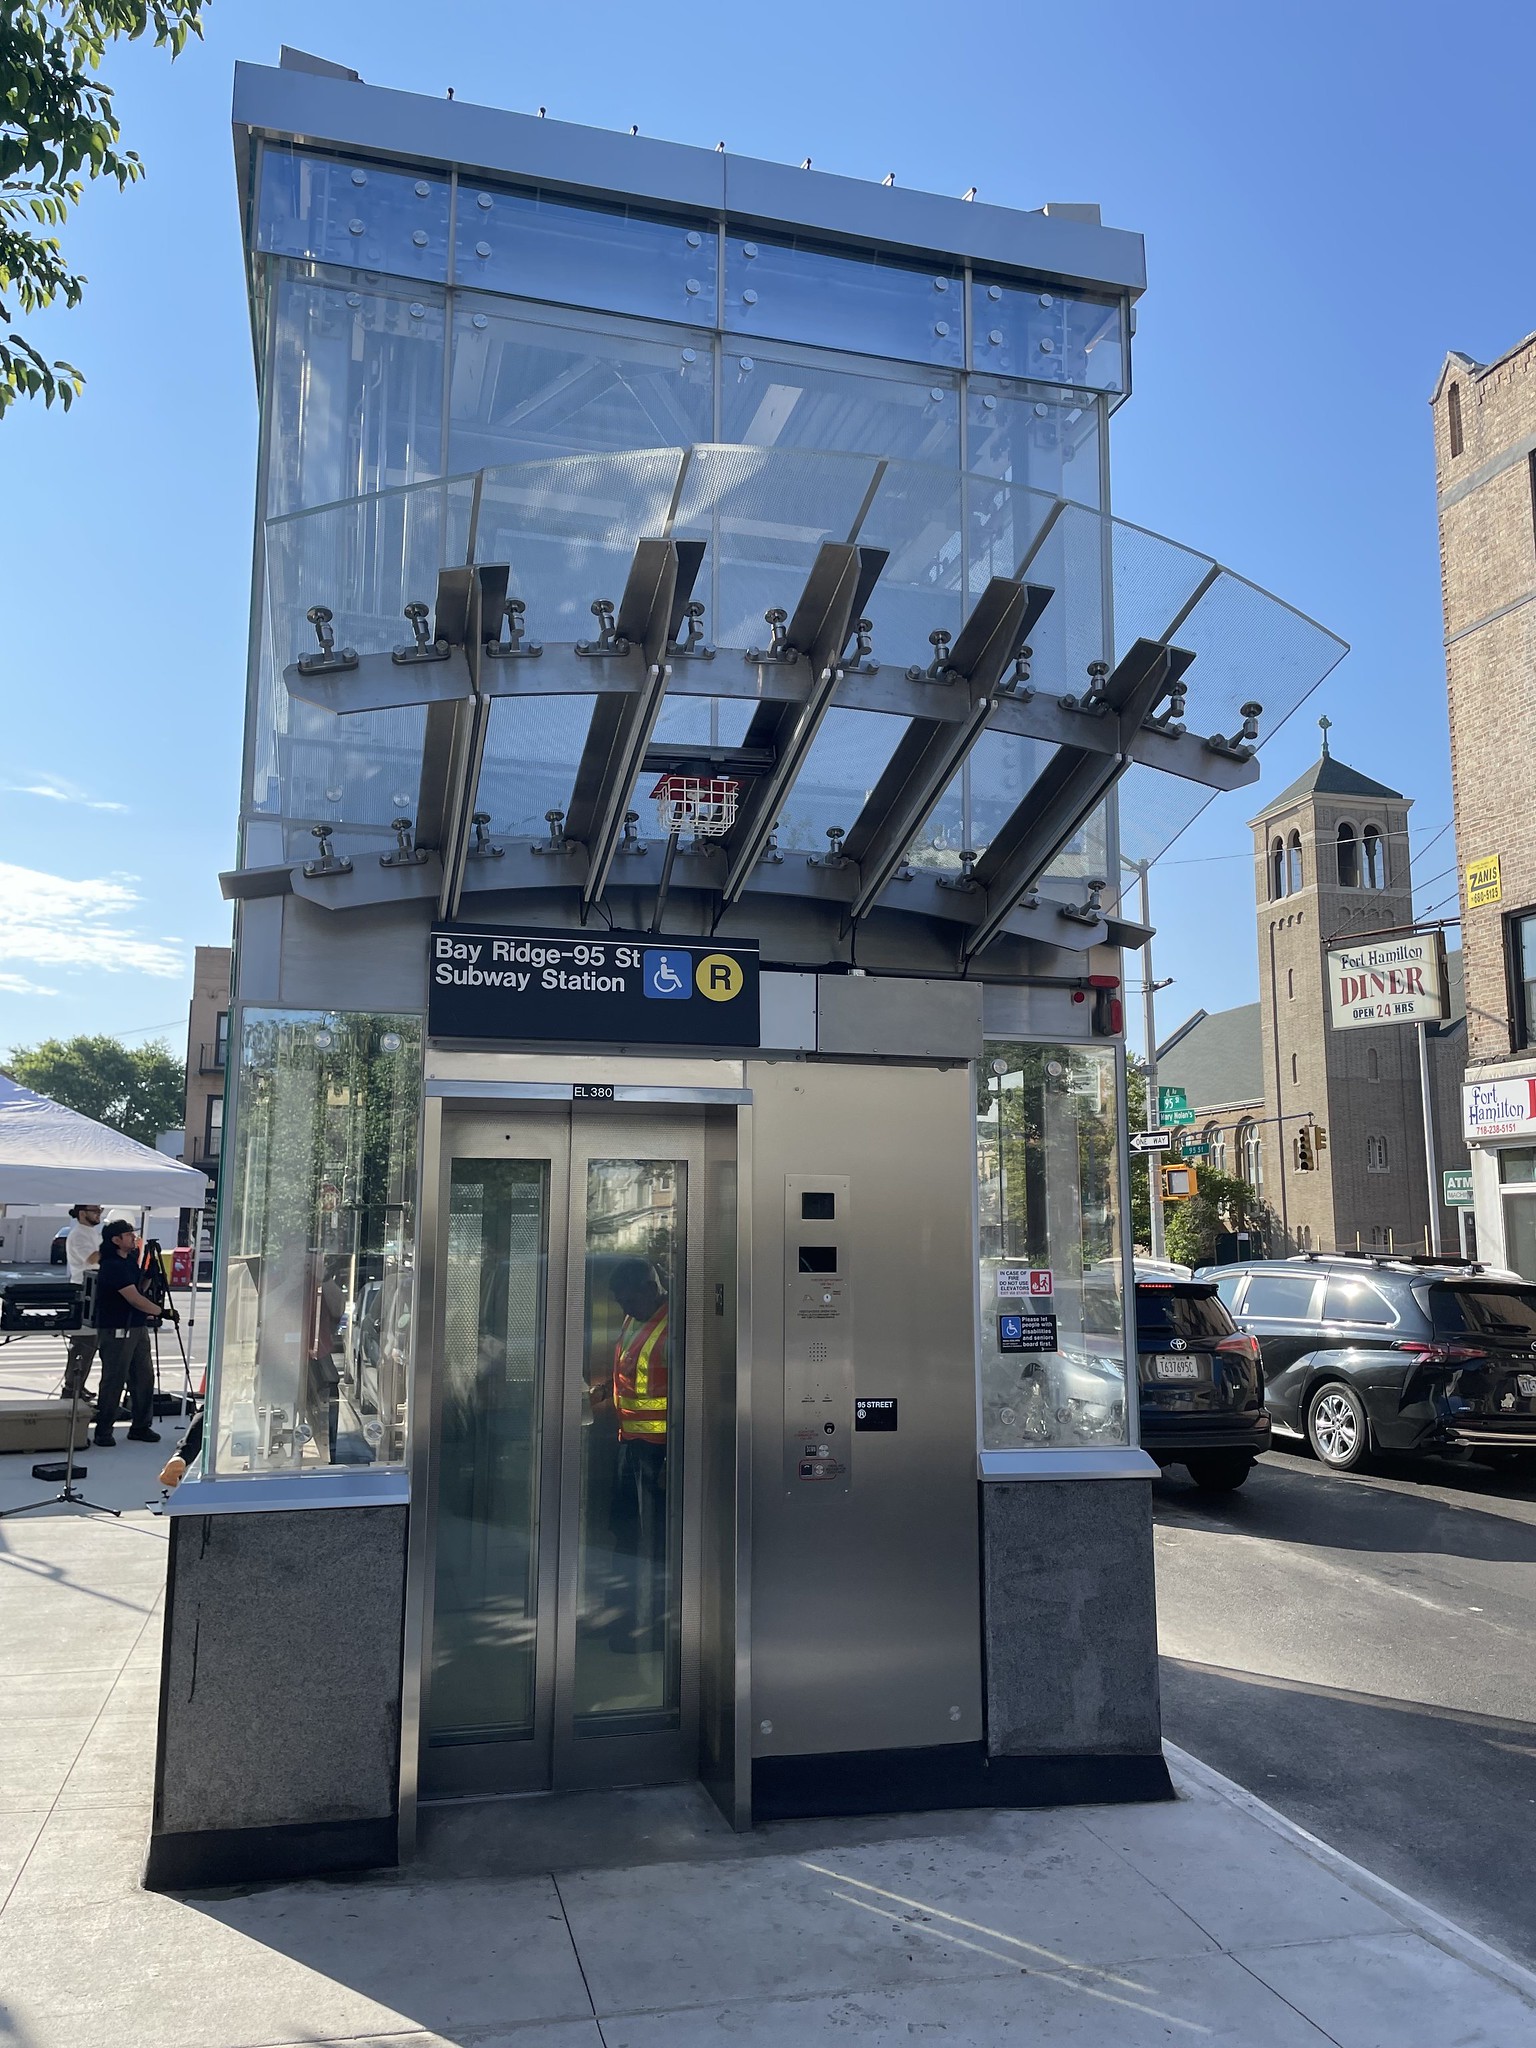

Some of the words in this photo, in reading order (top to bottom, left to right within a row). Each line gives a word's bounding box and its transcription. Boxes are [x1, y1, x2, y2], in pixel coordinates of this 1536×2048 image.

[1470, 867, 1498, 892] ZANIS
[435, 938, 482, 964] Bay
[492, 941, 606, 968] Ridge-95
[615, 947, 641, 969] St
[1341, 953, 1365, 970] Fort
[1368, 944, 1422, 967] Hamilton
[435, 963, 531, 992] Subway
[541, 968, 625, 992] Station
[710, 964, 731, 990] R
[1339, 967, 1425, 1006] DINER
[1353, 1008, 1374, 1019] OPEN
[1376, 1003, 1391, 1018] 24
[1394, 1002, 1414, 1014] HRS
[574, 1087, 589, 1097] EL
[590, 1087, 613, 1098] 380
[1164, 1098, 1174, 1109] 95
[1472, 1084, 1498, 1105] Fort
[1469, 1098, 1524, 1125] Hamilton
[1476, 1123, 1516, 1135] 718-238-5151
[1447, 1177, 1473, 1189] ATM
